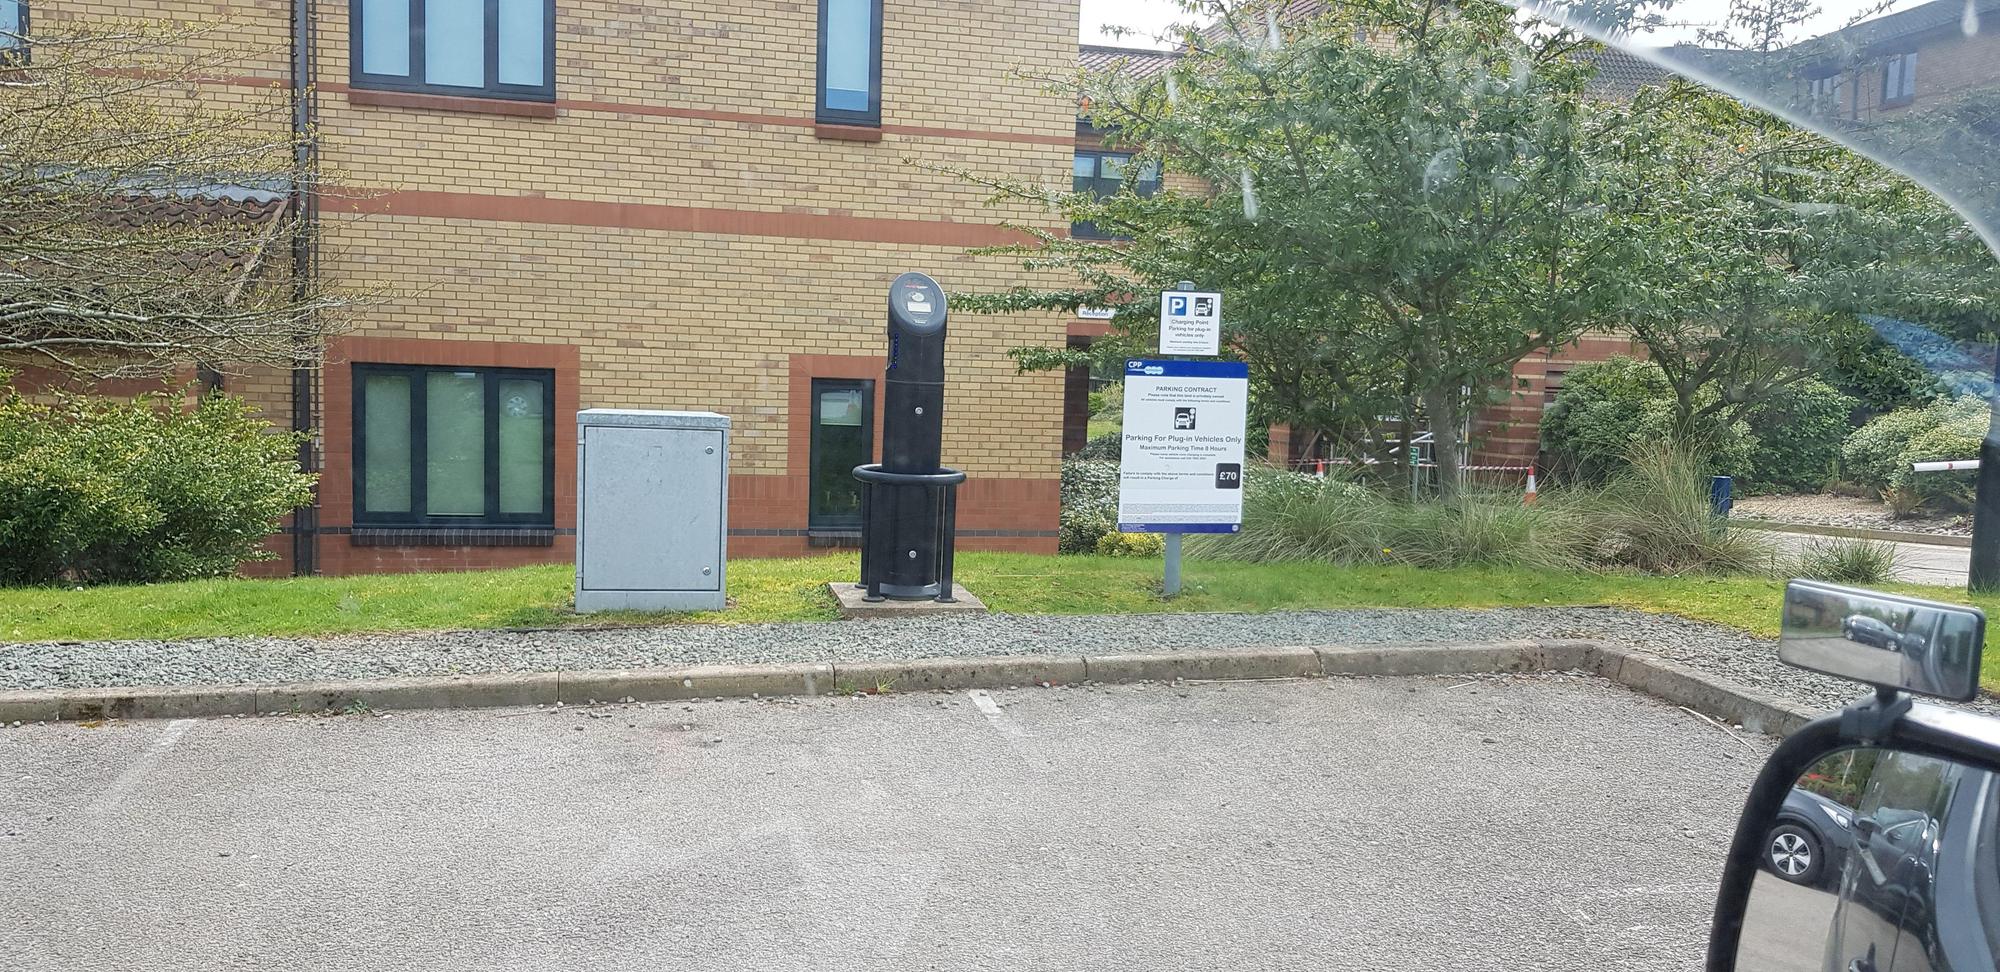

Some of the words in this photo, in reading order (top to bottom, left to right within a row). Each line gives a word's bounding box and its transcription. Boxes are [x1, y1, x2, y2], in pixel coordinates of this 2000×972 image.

[1171, 298, 1184, 314] P
[1125, 434, 1152, 442] Parking
[1168, 435, 1193, 443] Plug-in
[1225, 436, 1242, 444] Only
[1219, 471, 1237, 481] £70
